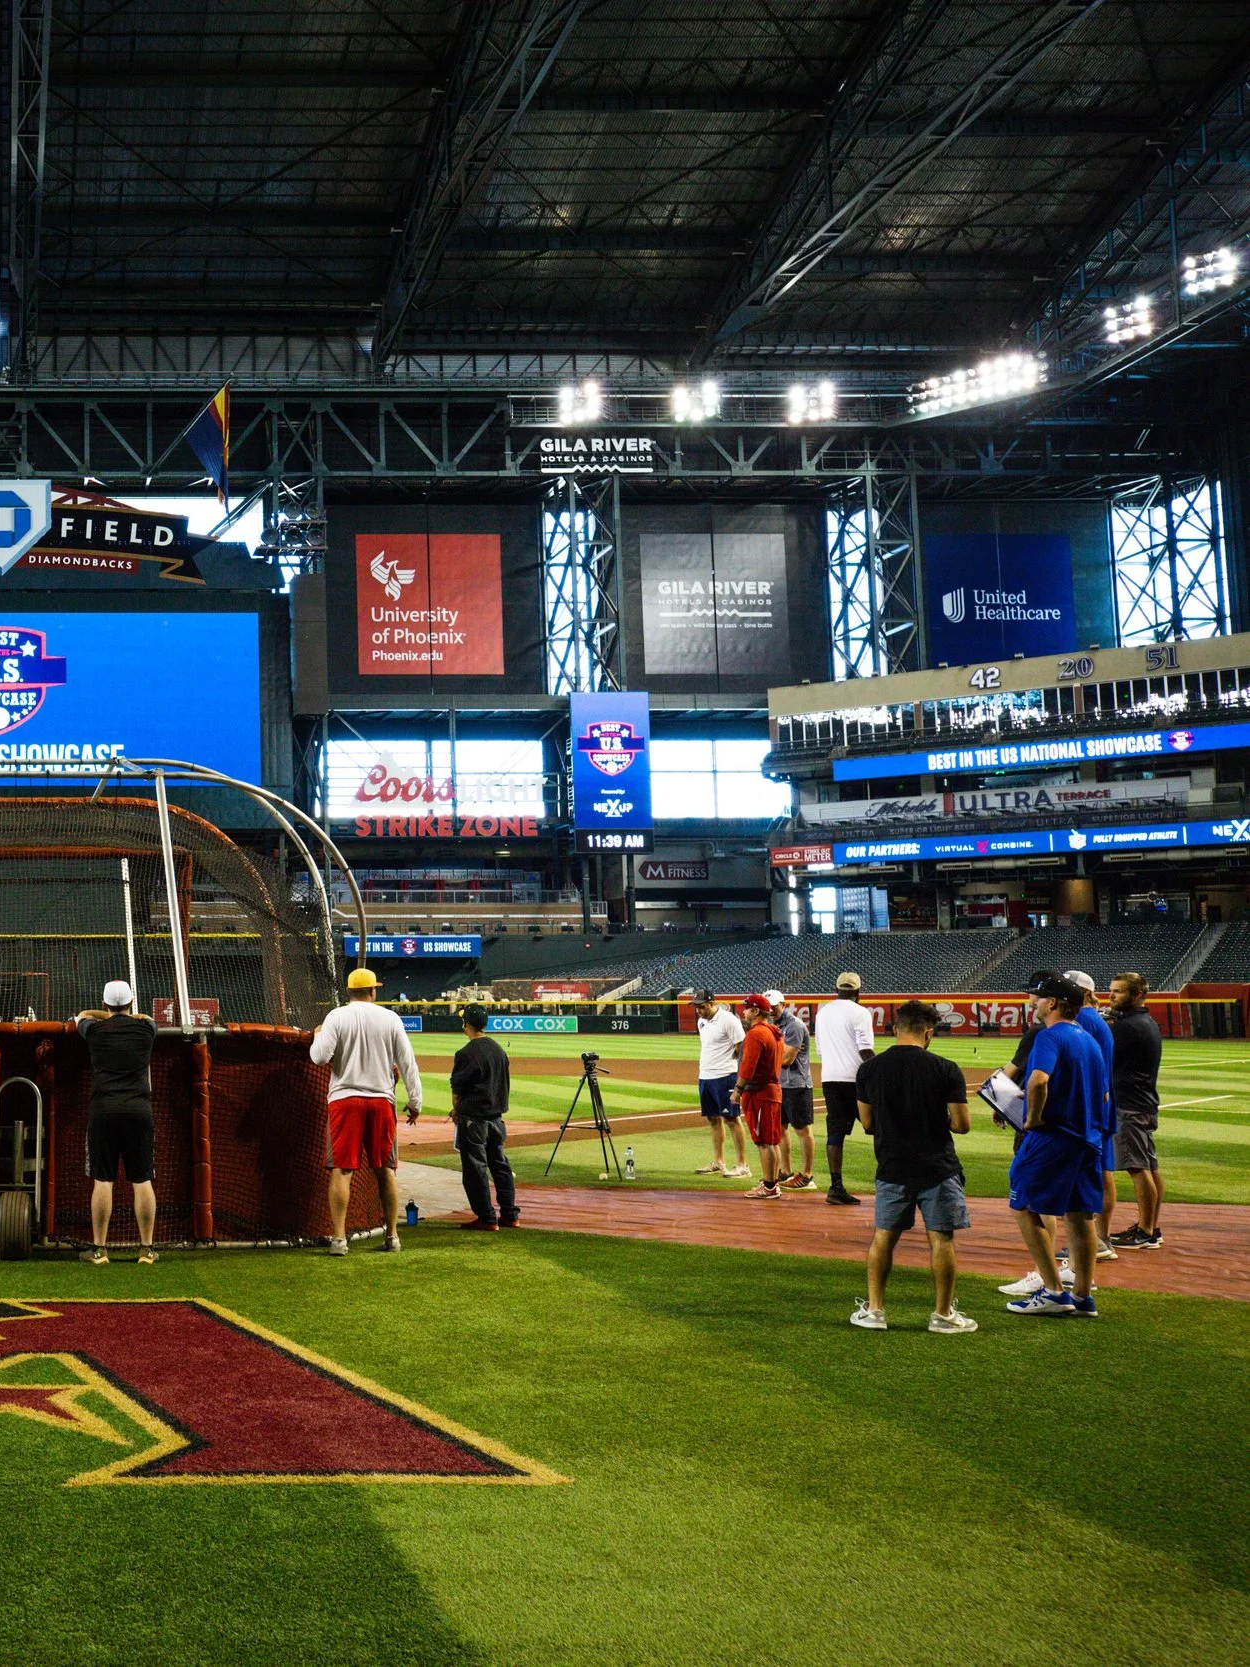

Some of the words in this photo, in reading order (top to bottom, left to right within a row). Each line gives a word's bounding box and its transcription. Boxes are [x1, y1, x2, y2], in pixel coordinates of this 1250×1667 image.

[540, 438, 588, 452] GILA
[591, 438, 652, 452] RIVER
[60, 517, 175, 547] FIELD
[29, 555, 133, 570] DIAMONDBACKS
[658, 581, 705, 595] GILA
[709, 581, 771, 595] RIVER
[973, 590, 1027, 605] United
[371, 607, 459, 627] University
[975, 605, 1061, 620] Healthcare
[372, 628, 391, 644] of
[394, 628, 463, 644] Phoenix
[372, 650, 443, 661] Phoenix.edu
[1145, 645, 1180, 671] 51
[1057, 656, 1095, 680] 20
[969, 666, 1001, 689] 42
[928, 753, 958, 771] BEST
[959, 752, 974, 768] IN
[975, 750, 999, 767] THE
[1000, 748, 1018, 765] US
[1020, 742, 1084, 763] NATIONAL
[1086, 735, 1162, 757] SHOWCASE
[354, 764, 457, 803] Coors
[461, 777, 548, 803] LIGHT
[959, 789, 1053, 811] ULTRA
[1055, 789, 1110, 801] TERRACE
[355, 814, 454, 837] STRIKE
[459, 814, 538, 837] ZONE
[1212, 819, 1249, 840] NEX
[587, 835, 622, 848] 11:39
[624, 835, 644, 847] AM
[804, 853, 830, 861] METER
[846, 846, 867, 858] OUR
[668, 868, 707, 878] FITNESS
[372, 942, 380, 951] IN
[381, 942, 394, 951] THE
[424, 942, 433, 952] US
[434, 942, 471, 952] SHOWCASE
[493, 1019, 523, 1030] COX
[534, 1019, 566, 1030] COX
[611, 1020, 629, 1030] 376
